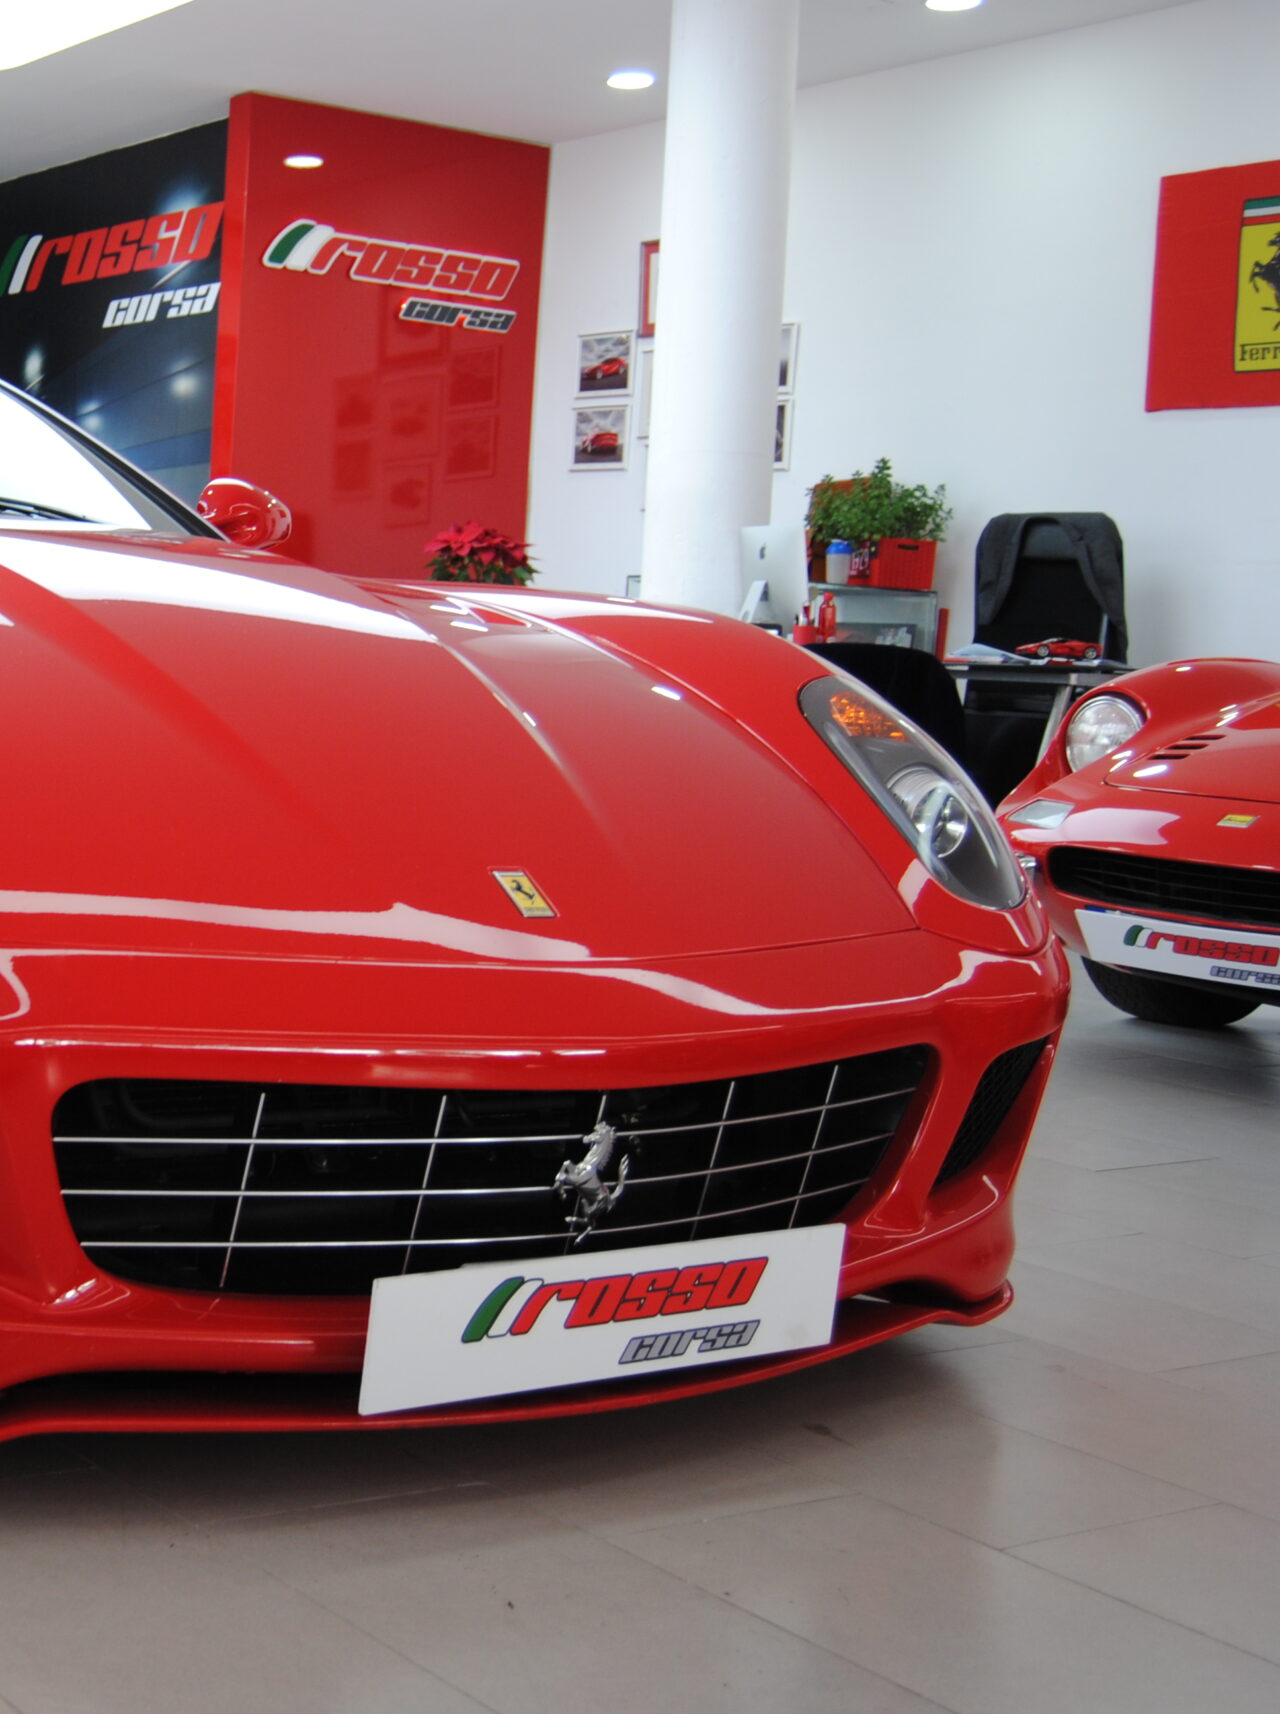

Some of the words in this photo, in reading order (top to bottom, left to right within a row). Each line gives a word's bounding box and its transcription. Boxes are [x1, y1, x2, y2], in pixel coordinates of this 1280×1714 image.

[25, 200, 224, 292] rosso
[311, 236, 519, 300] rosso
[102, 281, 220, 329] corsa
[399, 297, 516, 333] corsa
[1147, 931, 1279, 966] rosso
[509, 1256, 769, 1335] rosso
[618, 1319, 761, 1364] corsa
